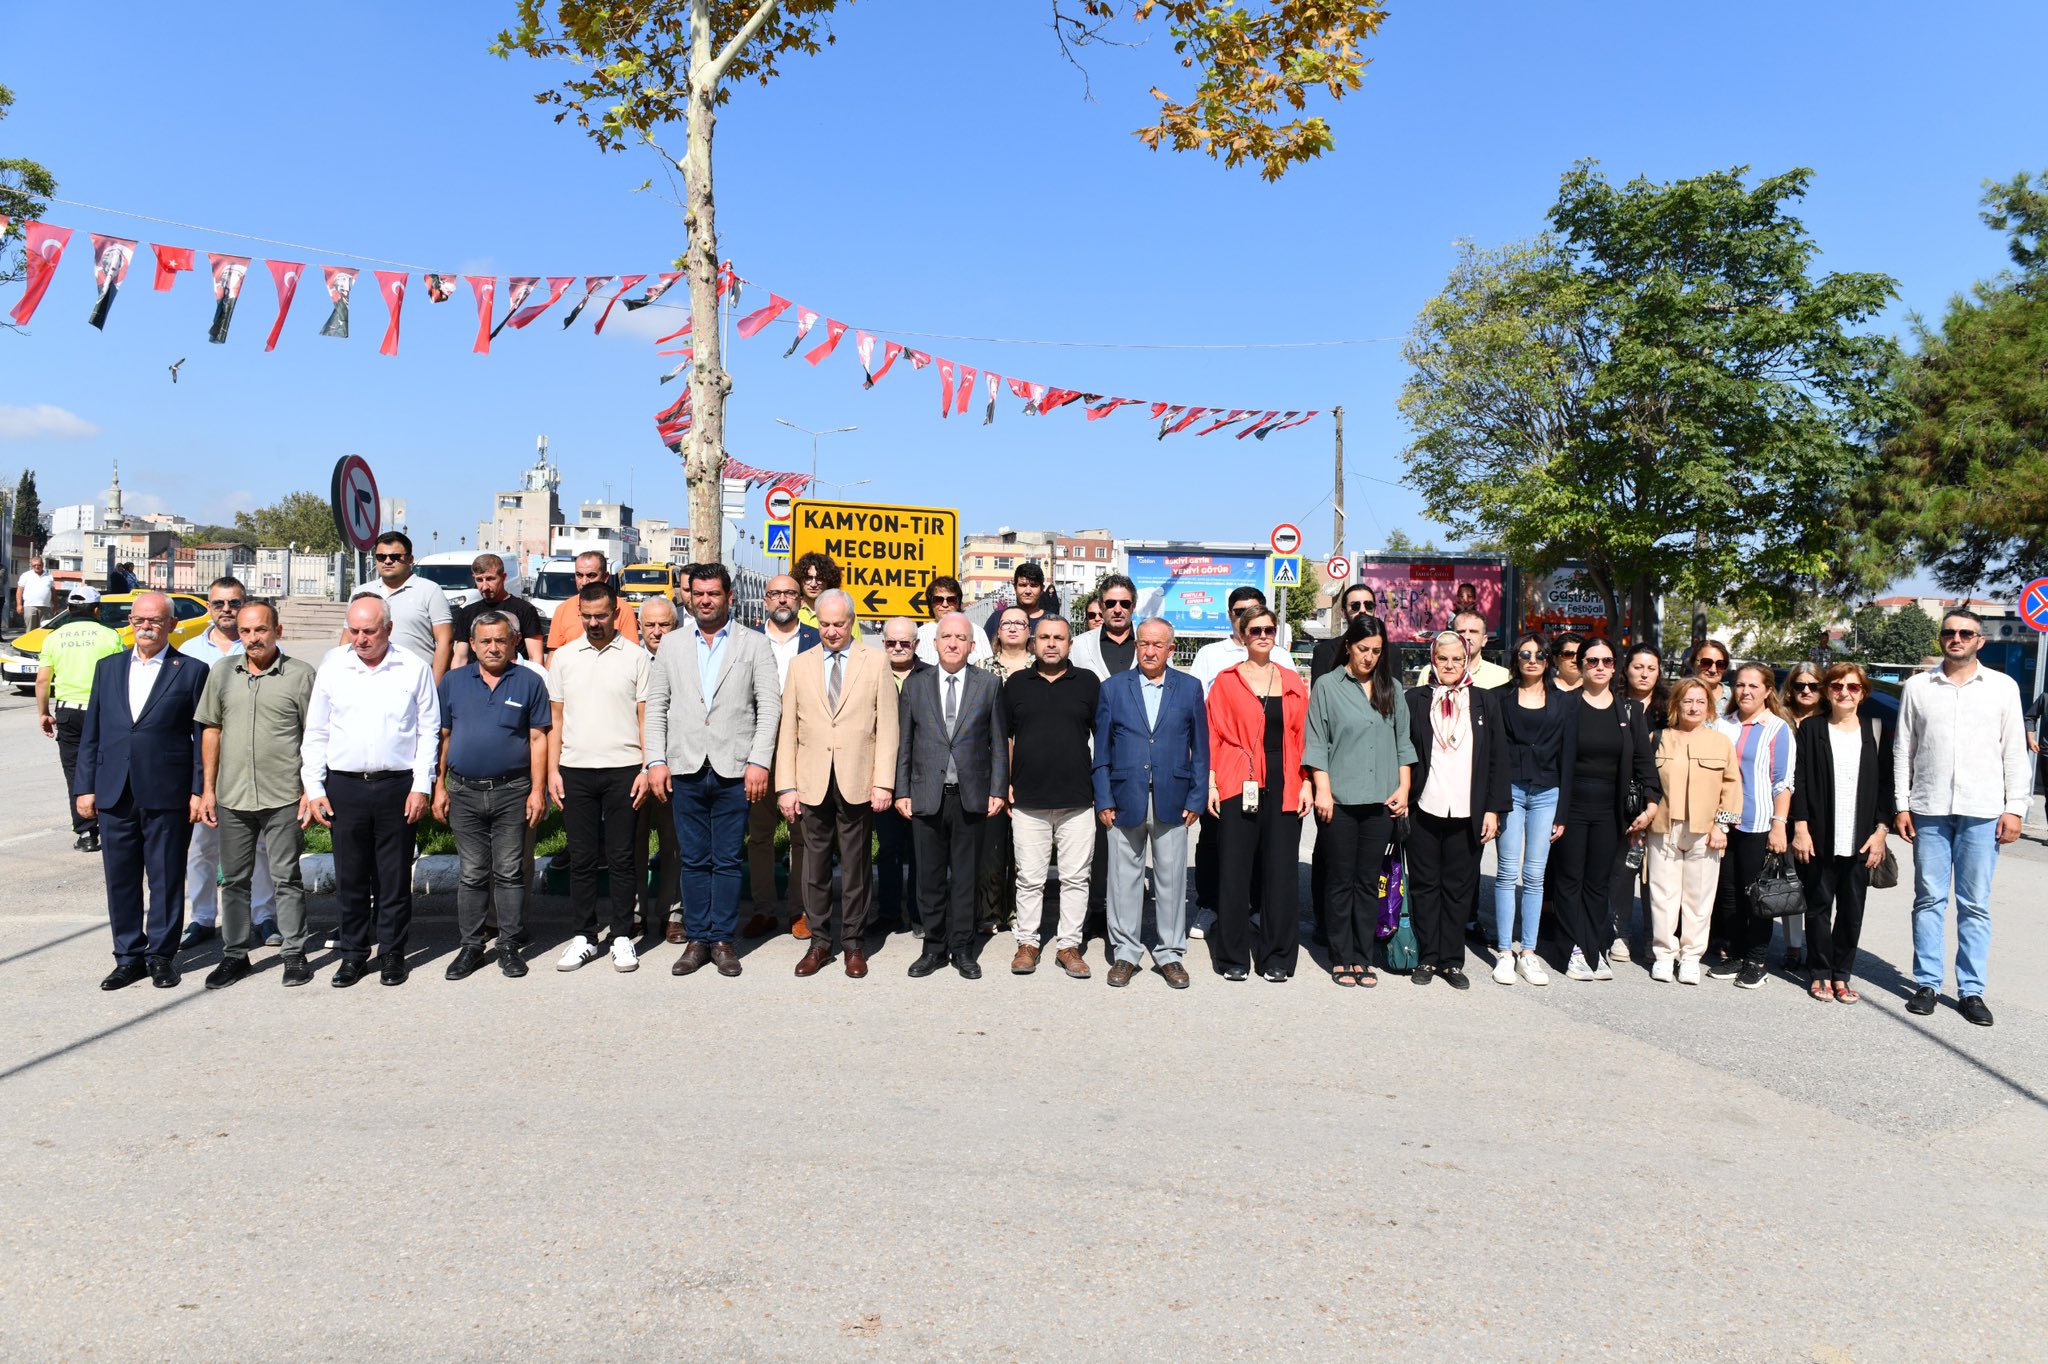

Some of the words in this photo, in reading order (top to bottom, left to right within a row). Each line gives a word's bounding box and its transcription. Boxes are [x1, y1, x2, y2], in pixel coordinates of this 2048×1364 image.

[805, 510, 944, 535] KAMYON-TIR
[825, 538, 924, 561] MECBURİ
[840, 562, 937, 588] İKAMETİ
[1201, 565, 1229, 574] GÖTÜR
